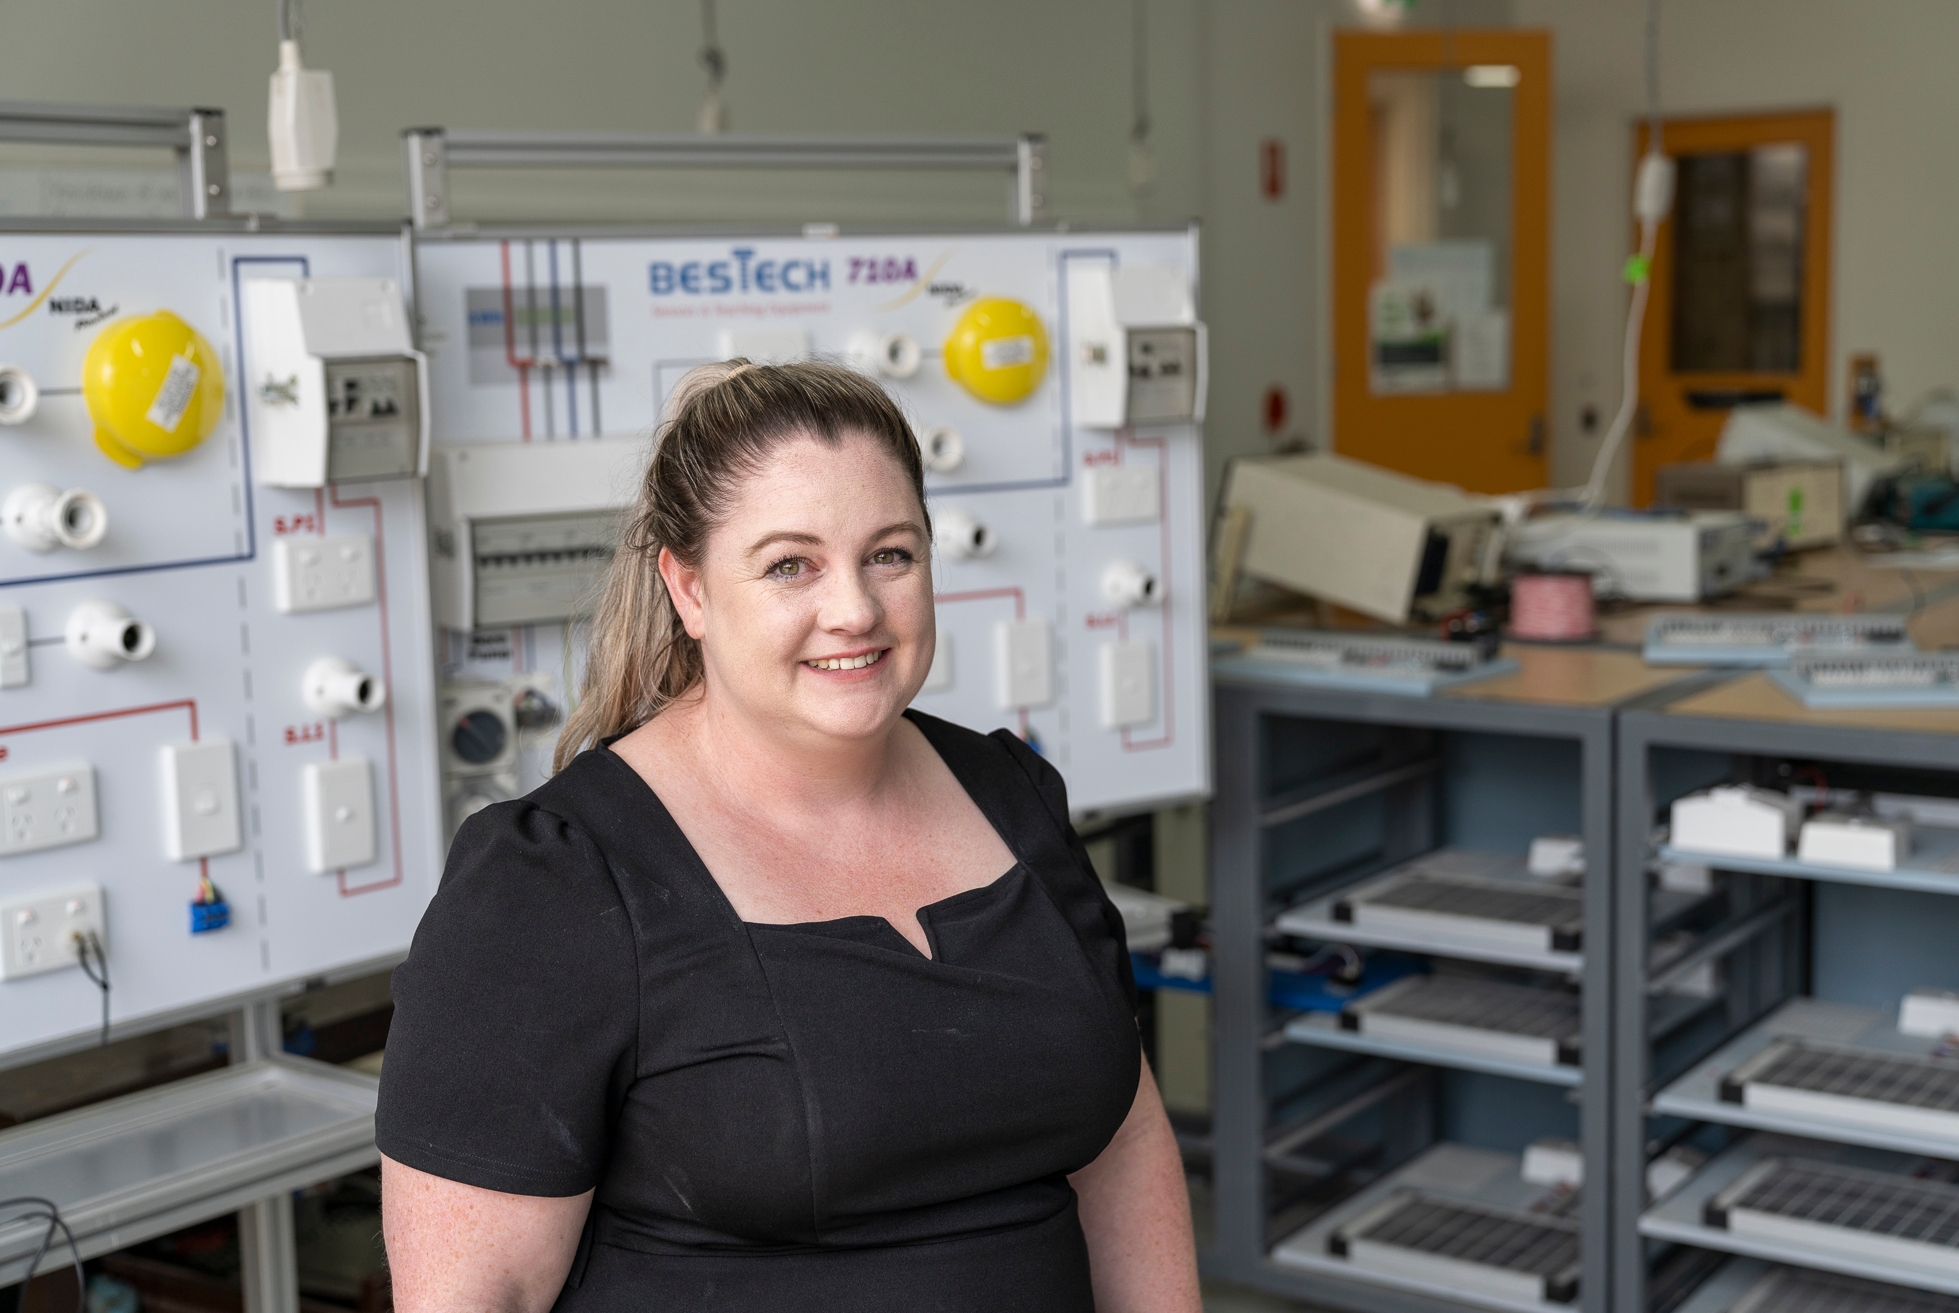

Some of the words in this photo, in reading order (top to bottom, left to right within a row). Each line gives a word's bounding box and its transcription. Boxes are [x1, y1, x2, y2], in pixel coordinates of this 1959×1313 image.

[0, 262, 33, 295] A
[649, 247, 830, 295] BESTECH
[849, 257, 917, 283] 710A
[48, 297, 101, 314] NIDA
